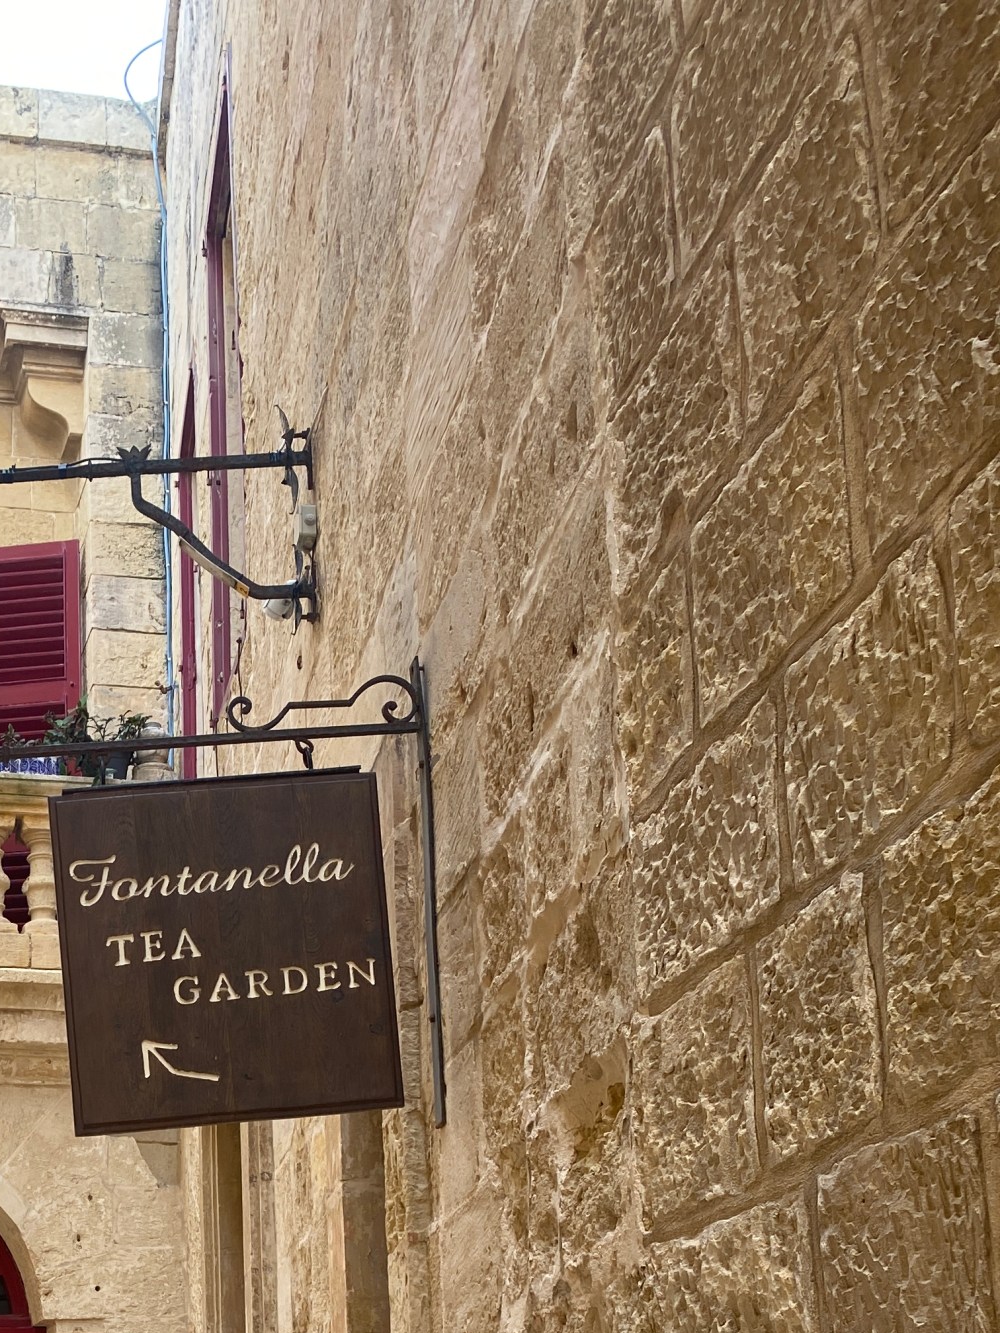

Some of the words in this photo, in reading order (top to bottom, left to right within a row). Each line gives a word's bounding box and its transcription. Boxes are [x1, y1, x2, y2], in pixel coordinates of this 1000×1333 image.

[69, 842, 355, 907] Fontanella
[105, 927, 202, 967] TEA
[173, 958, 377, 1005] GARDEN
